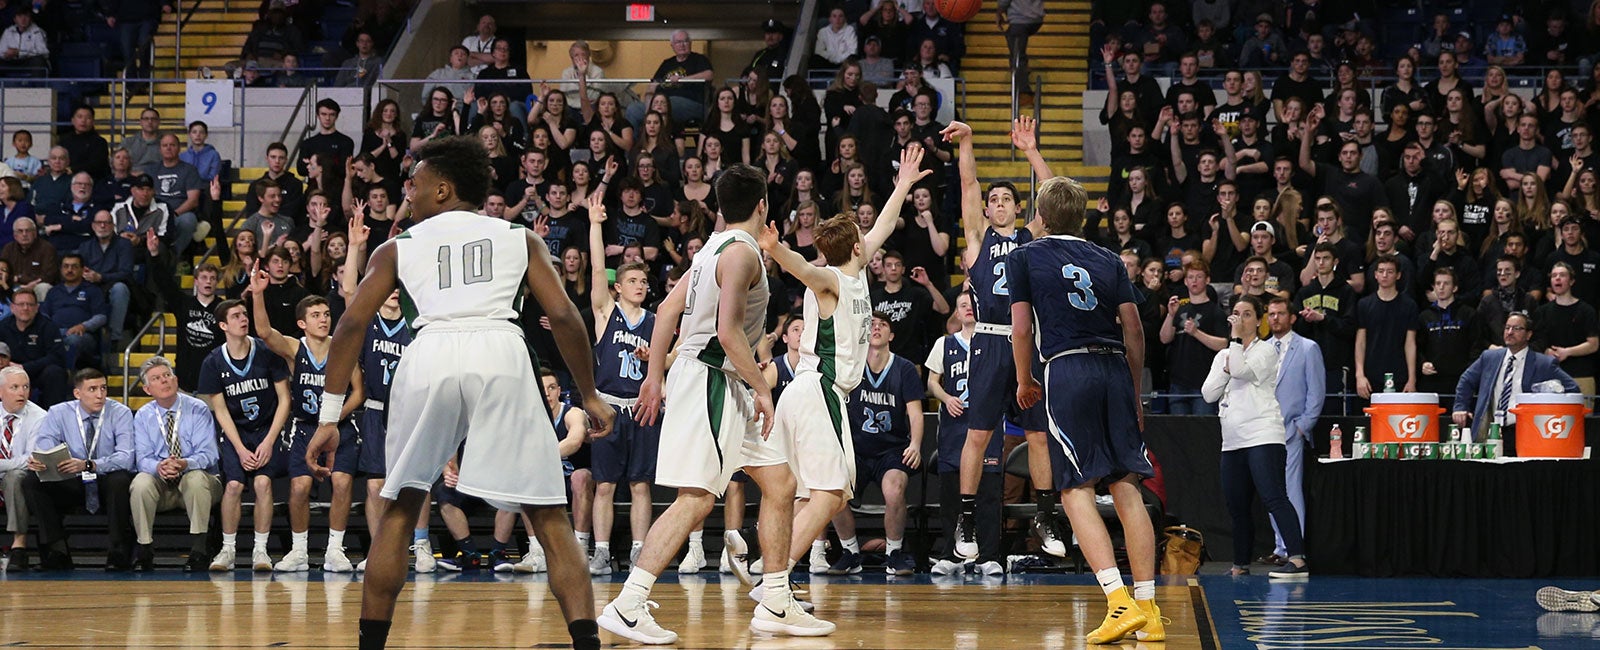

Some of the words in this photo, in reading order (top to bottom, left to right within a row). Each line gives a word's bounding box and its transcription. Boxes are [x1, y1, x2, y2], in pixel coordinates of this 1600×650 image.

[202, 92, 217, 114] 9
[989, 241, 1019, 261] FRAN
[437, 238, 493, 290] 10
[1061, 263, 1098, 311] 3
[225, 379, 269, 398] FRANKLIN
[240, 397, 258, 421] 5
[302, 389, 323, 415] 3
[861, 407, 891, 434] 23
[1401, 417, 1416, 434] G
[1547, 418, 1562, 434] G
